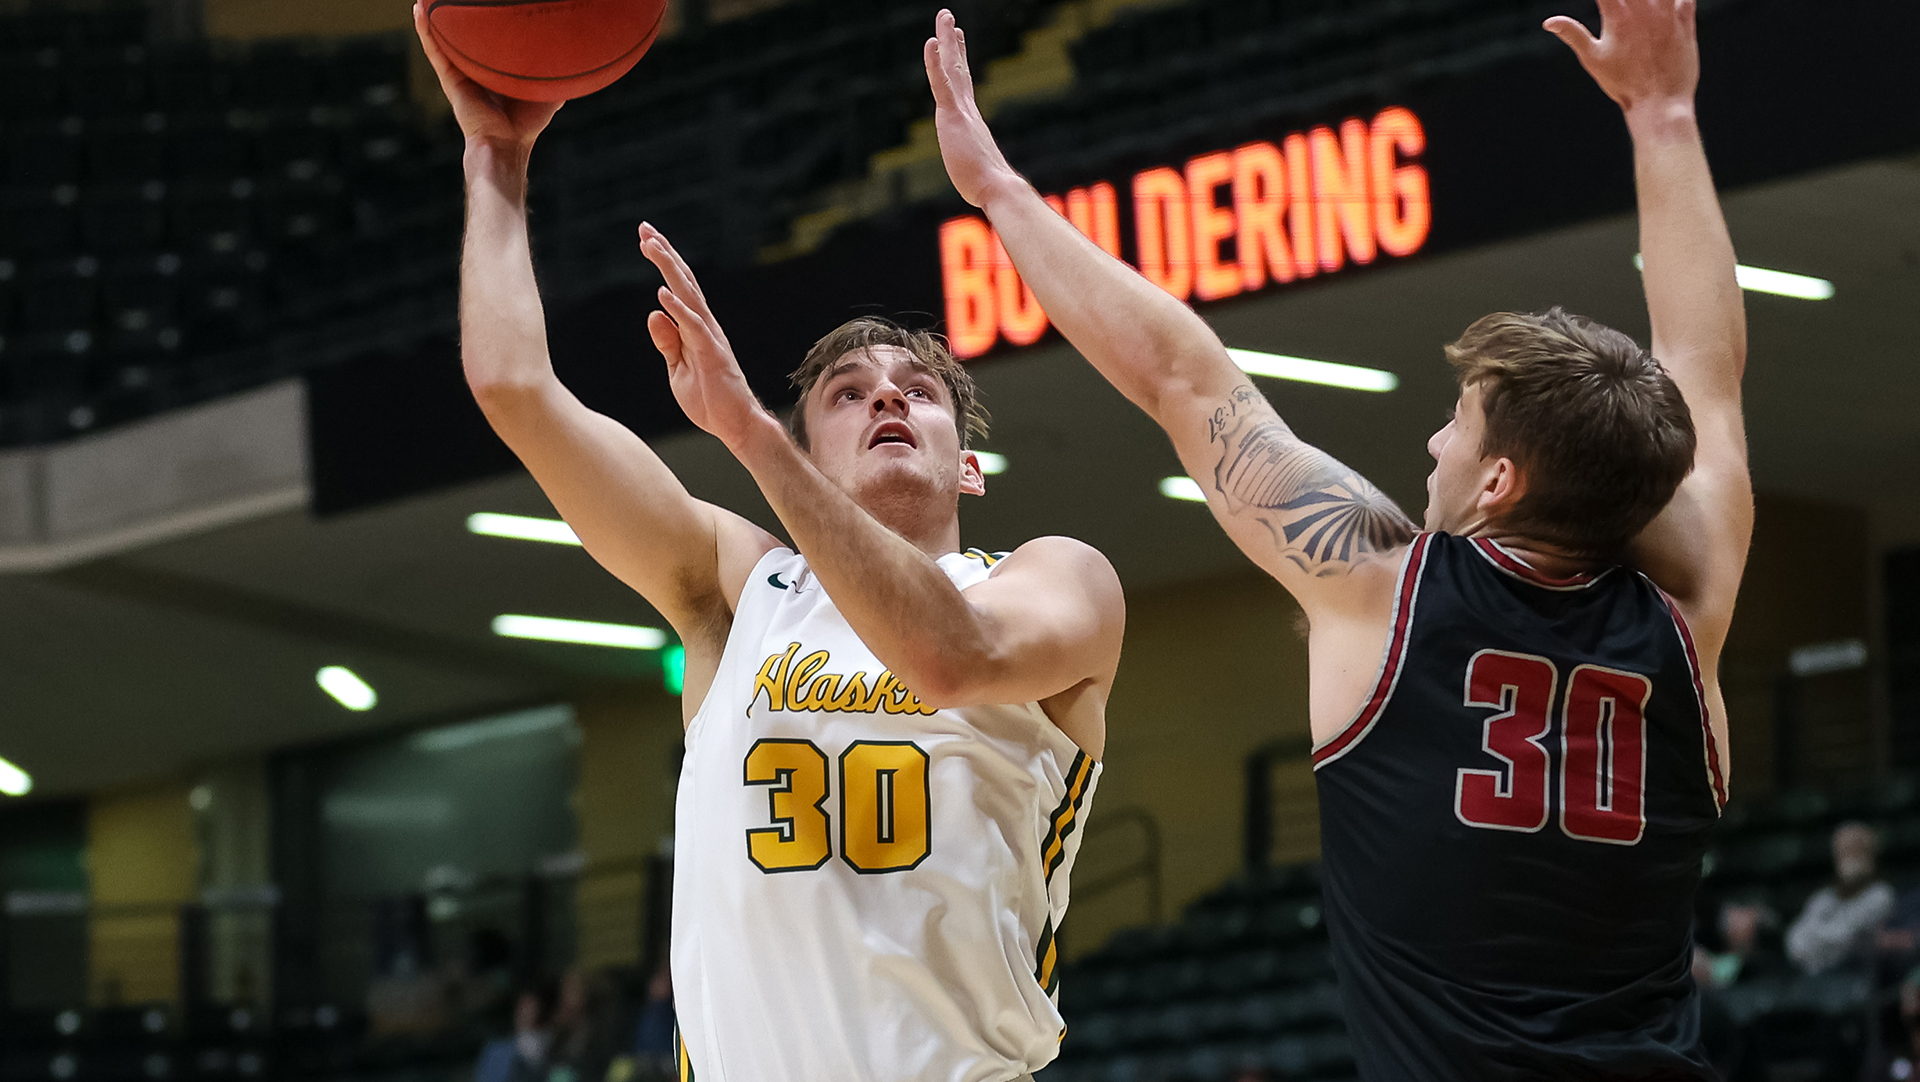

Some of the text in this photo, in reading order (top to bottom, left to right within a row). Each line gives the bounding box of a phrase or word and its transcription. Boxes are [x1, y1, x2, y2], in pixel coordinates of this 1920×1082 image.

[938, 105, 1432, 359] BODERING
[743, 738, 933, 875] 30
[1453, 648, 1653, 846] 30
